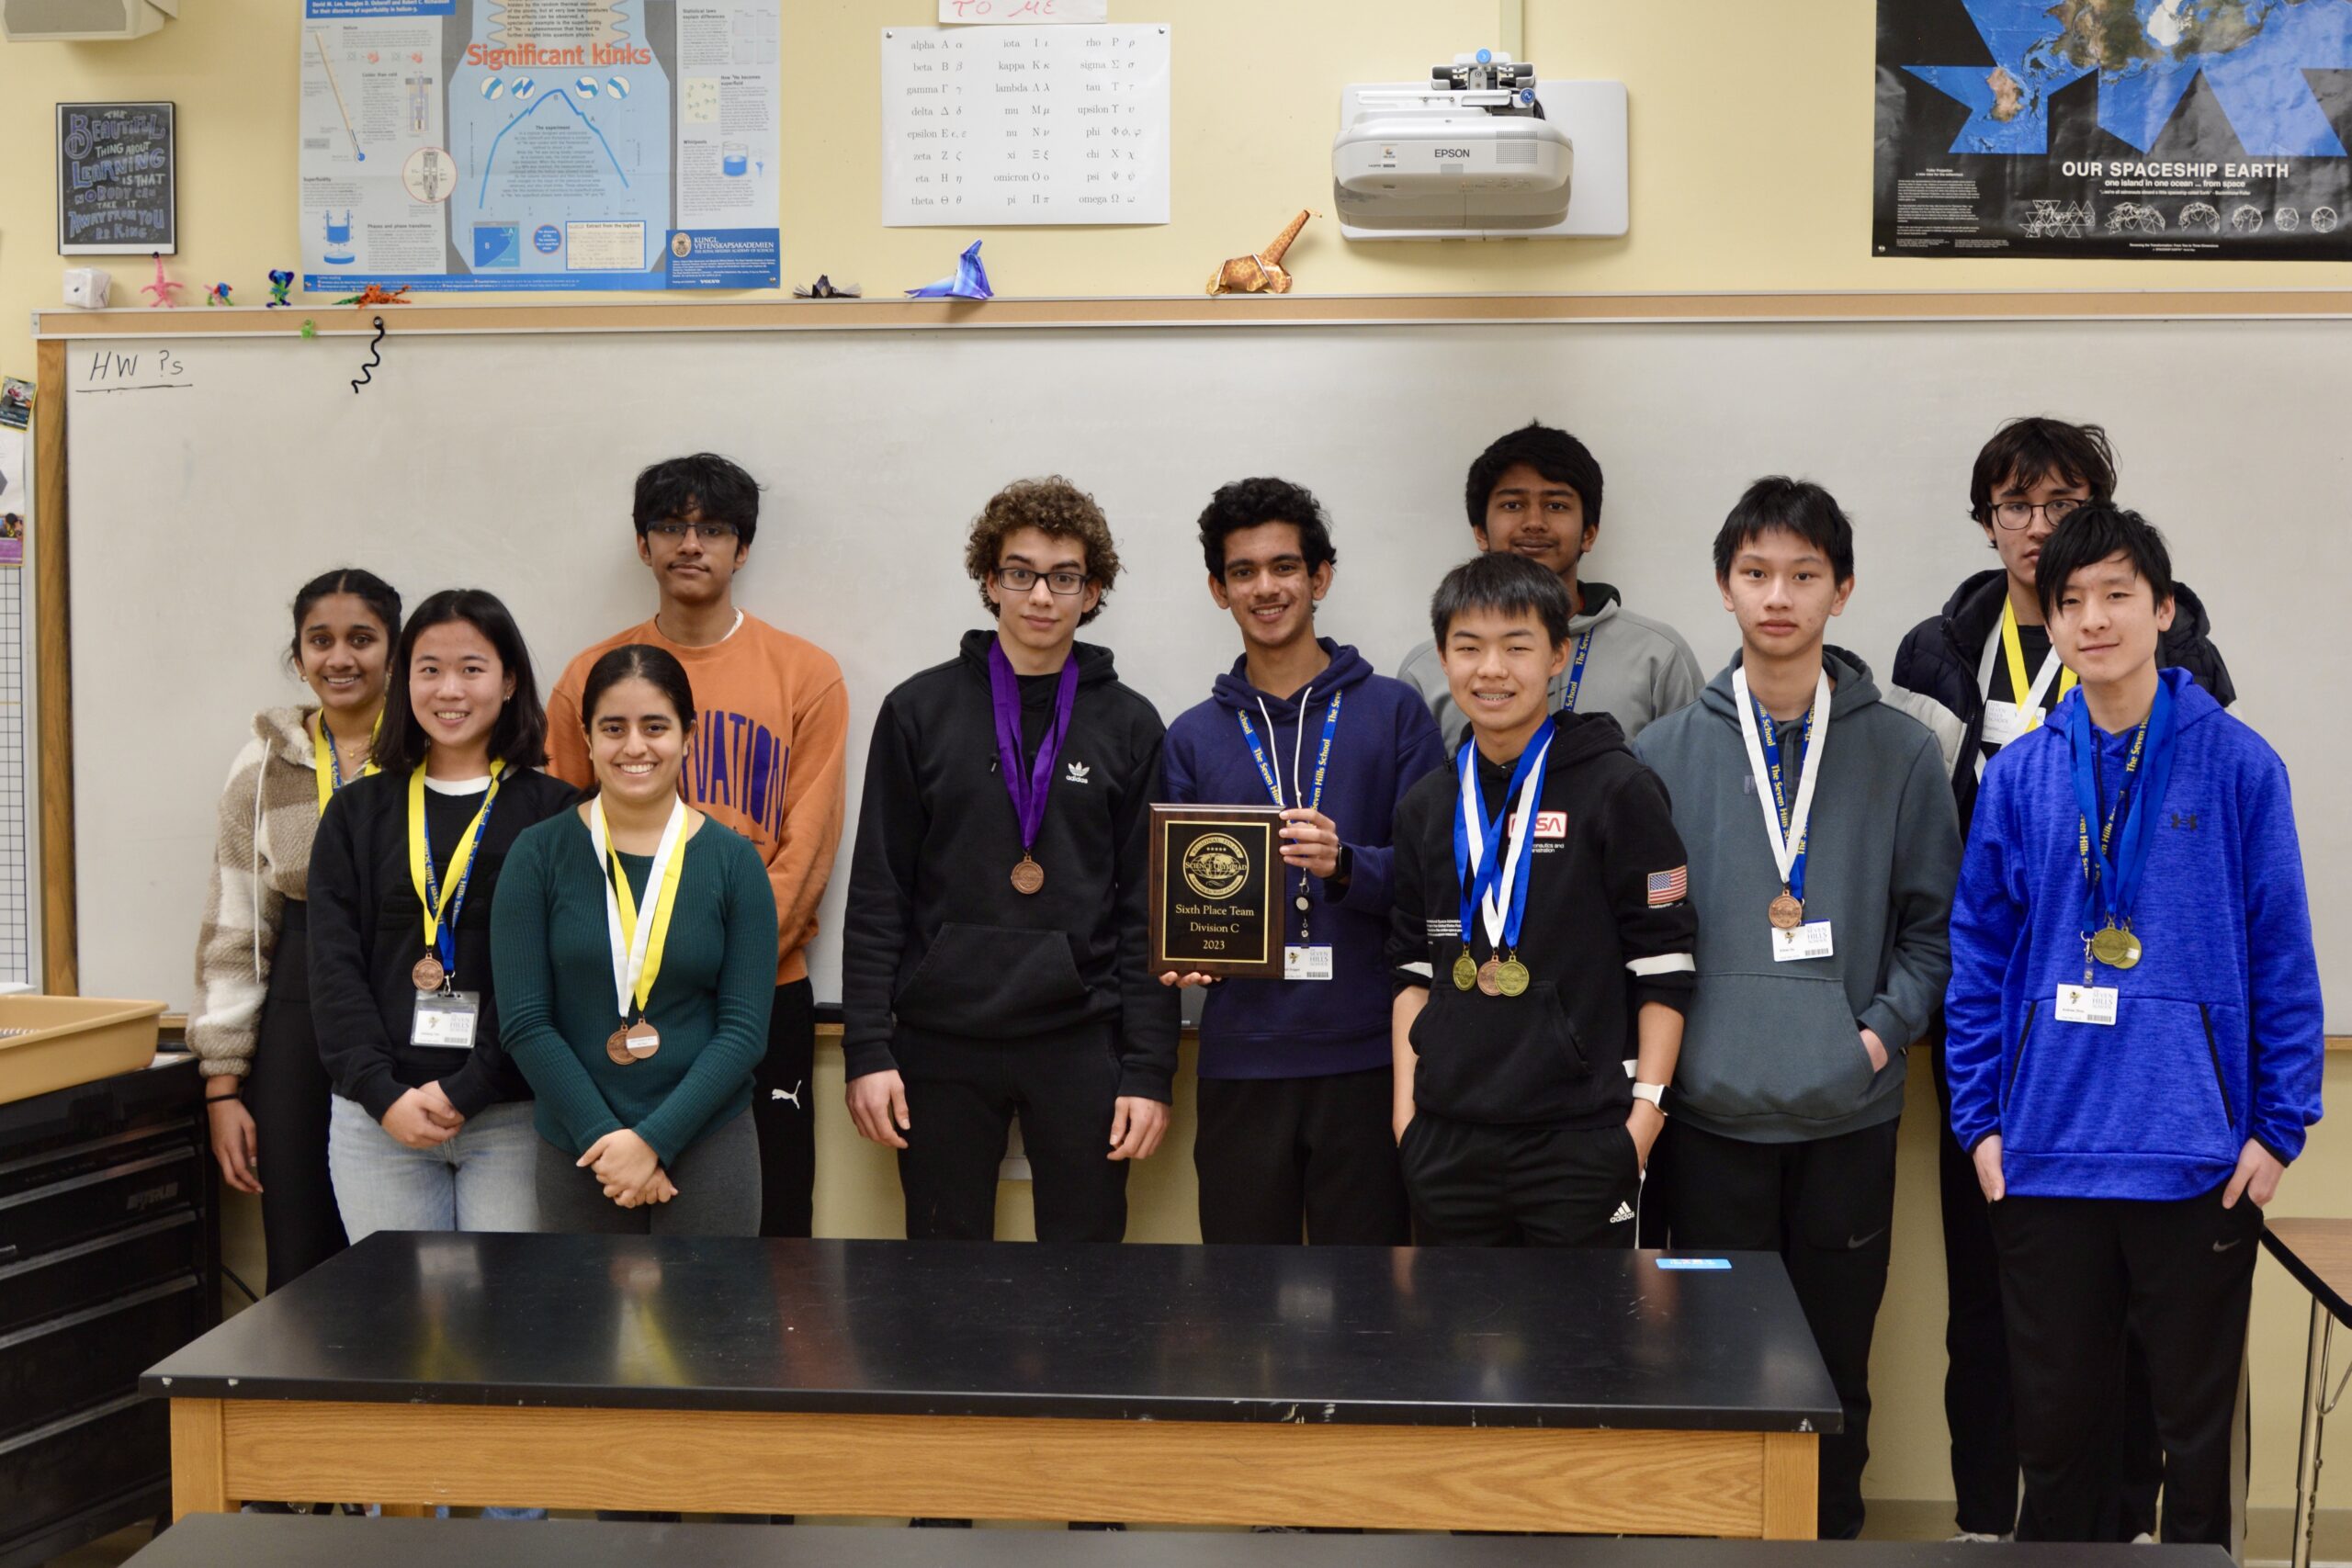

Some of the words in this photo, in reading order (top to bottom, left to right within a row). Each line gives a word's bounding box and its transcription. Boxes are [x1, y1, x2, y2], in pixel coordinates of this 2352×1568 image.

[953, 0, 992, 17] TO
[910, 39, 935, 52] alpha
[1003, 39, 1021, 49] iota
[1085, 37, 1102, 48] rho
[466, 42, 585, 71] Significant
[592, 43, 651, 65] kinks
[913, 62, 933, 72] beta
[998, 61, 1025, 73] kappa
[1080, 62, 1106, 72] sigma
[906, 86, 939, 96] gamma
[995, 82, 1029, 93] lambda
[1085, 83, 1101, 92] tau
[104, 109, 128, 118] THE
[910, 106, 933, 117] delta
[1077, 104, 1109, 117] upsilon
[65, 114, 166, 160] BEAUTIFUL
[907, 129, 938, 141] epsilon
[1086, 126, 1101, 139] phi
[95, 142, 124, 158] THING
[126, 141, 152, 155] ABOUT
[1086, 148, 1100, 159] chi
[1434, 149, 1470, 158] EPSON
[912, 152, 932, 162] zeta
[72, 148, 165, 189] LEARNING
[2062, 161, 2103, 176] OUR
[2109, 162, 2218, 178] SPACESHIP
[2224, 163, 2290, 178] EARTH
[121, 175, 133, 186] IS
[134, 174, 165, 186] THAT
[993, 173, 1029, 183] omicron
[1087, 172, 1100, 184] psi
[2203, 179, 2221, 188] from
[2222, 180, 2245, 189] space
[74, 186, 132, 205] NOBODY
[910, 196, 934, 206] theta
[1007, 195, 1016, 207] pi
[1078, 196, 1108, 206] omega
[96, 200, 118, 209] TAKE
[68, 210, 106, 239] AWAY
[107, 209, 137, 222] FROM
[138, 209, 165, 229] YOU
[89, 351, 138, 381] HW
[1328, 709, 1337, 723] The
[1763, 719, 1776, 746] School
[2131, 730, 2145, 755] Seven
[1318, 739, 1330, 765] School
[1254, 747, 1263, 762] The
[1260, 762, 1272, 785] Seven
[2126, 756, 2138, 773] The
[1315, 767, 1325, 785] Hills
[1771, 763, 1781, 780] The
[1066, 774, 1089, 784] adidas
[1774, 782, 1784, 807] Seven
[2079, 835, 2089, 856] Hills
[1175, 904, 1200, 915] Sixth
[1203, 905, 1227, 915] Place
[1229, 906, 1254, 916] Team
[1190, 922, 1228, 932] Division
[1230, 924, 1239, 933] C
[1203, 940, 1225, 949] 2023
[1610, 1212, 1635, 1224] adidas
